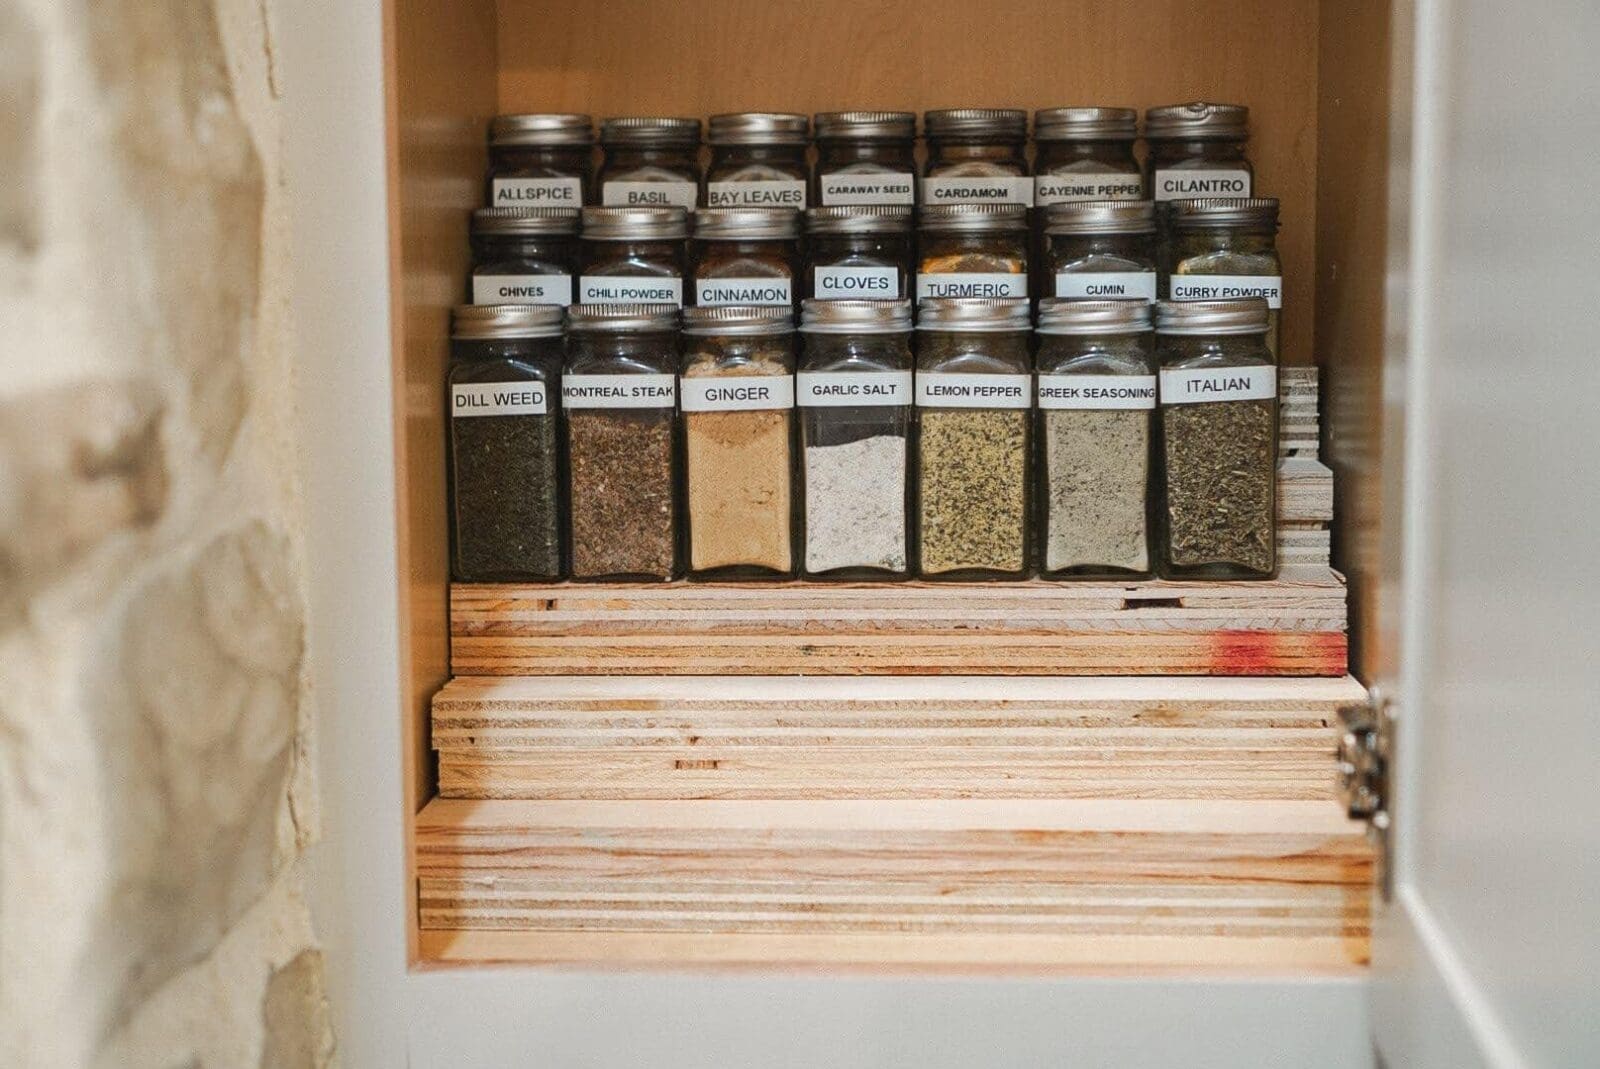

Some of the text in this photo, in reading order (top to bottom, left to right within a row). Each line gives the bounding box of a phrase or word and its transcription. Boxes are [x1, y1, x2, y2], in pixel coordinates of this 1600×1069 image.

[827, 185, 910, 194] CARAWAY SEED
[1039, 185, 1095, 196] CAYENNE
[1164, 179, 1244, 193] CILANTRO
[498, 187, 573, 200] ALLSPICE
[628, 191, 670, 204] BASIL
[710, 189, 802, 205] BAY LEAVES
[935, 187, 1008, 198] CARDAMOM
[823, 276, 888, 289] CLOVES
[499, 286, 544, 297] CHIVES
[587, 288, 674, 299] CHILI POWDER
[702, 288, 787, 302] CINNAMON
[927, 283, 1010, 297] TURMERIC
[1086, 285, 1125, 295] CUMIN
[1175, 286, 1278, 298] CURRY POWDER
[812, 385, 896, 396] GARLIC SALT
[926, 385, 1022, 397] LEMON PEPPER
[1187, 378, 1251, 393] ITALIAN
[563, 386, 673, 398] MONTREAL STEAK
[705, 387, 769, 402] GINGER
[1039, 388, 1155, 398] GREEK SEASONING
[455, 391, 543, 408] DILL WEED
